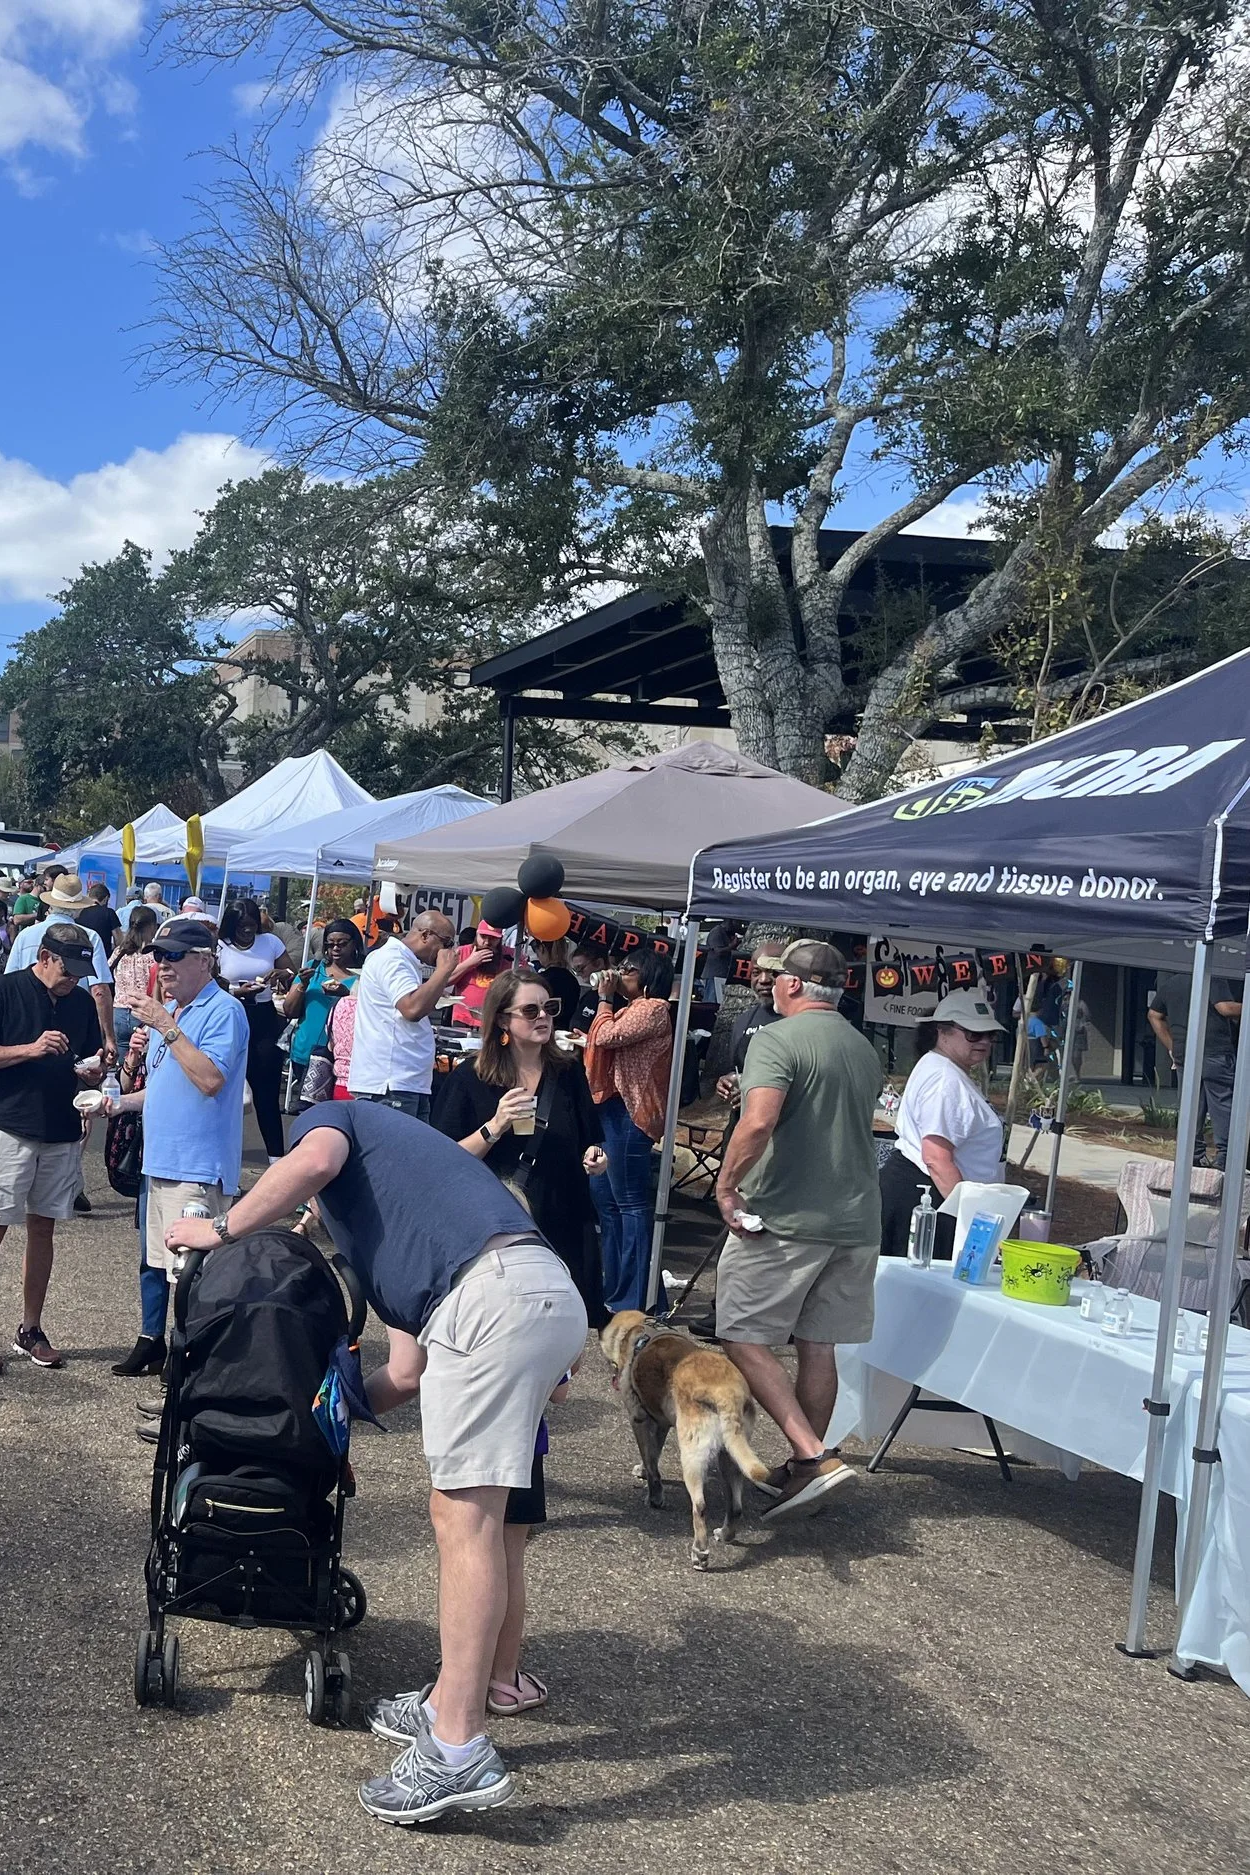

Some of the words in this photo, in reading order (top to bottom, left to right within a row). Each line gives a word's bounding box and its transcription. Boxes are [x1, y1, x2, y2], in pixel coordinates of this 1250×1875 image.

[953, 737, 1247, 814] MORA
[712, 866, 772, 893] Register
[775, 866, 792, 890] to
[795, 865, 815, 890] be
[818, 869, 841, 890] an
[844, 869, 902, 896] organ,
[908, 870, 947, 896] eye
[947, 865, 995, 893] and
[996, 866, 1074, 896] tissue
[1078, 868, 1164, 901] donor.
[889, 1003, 906, 1015] FINE
